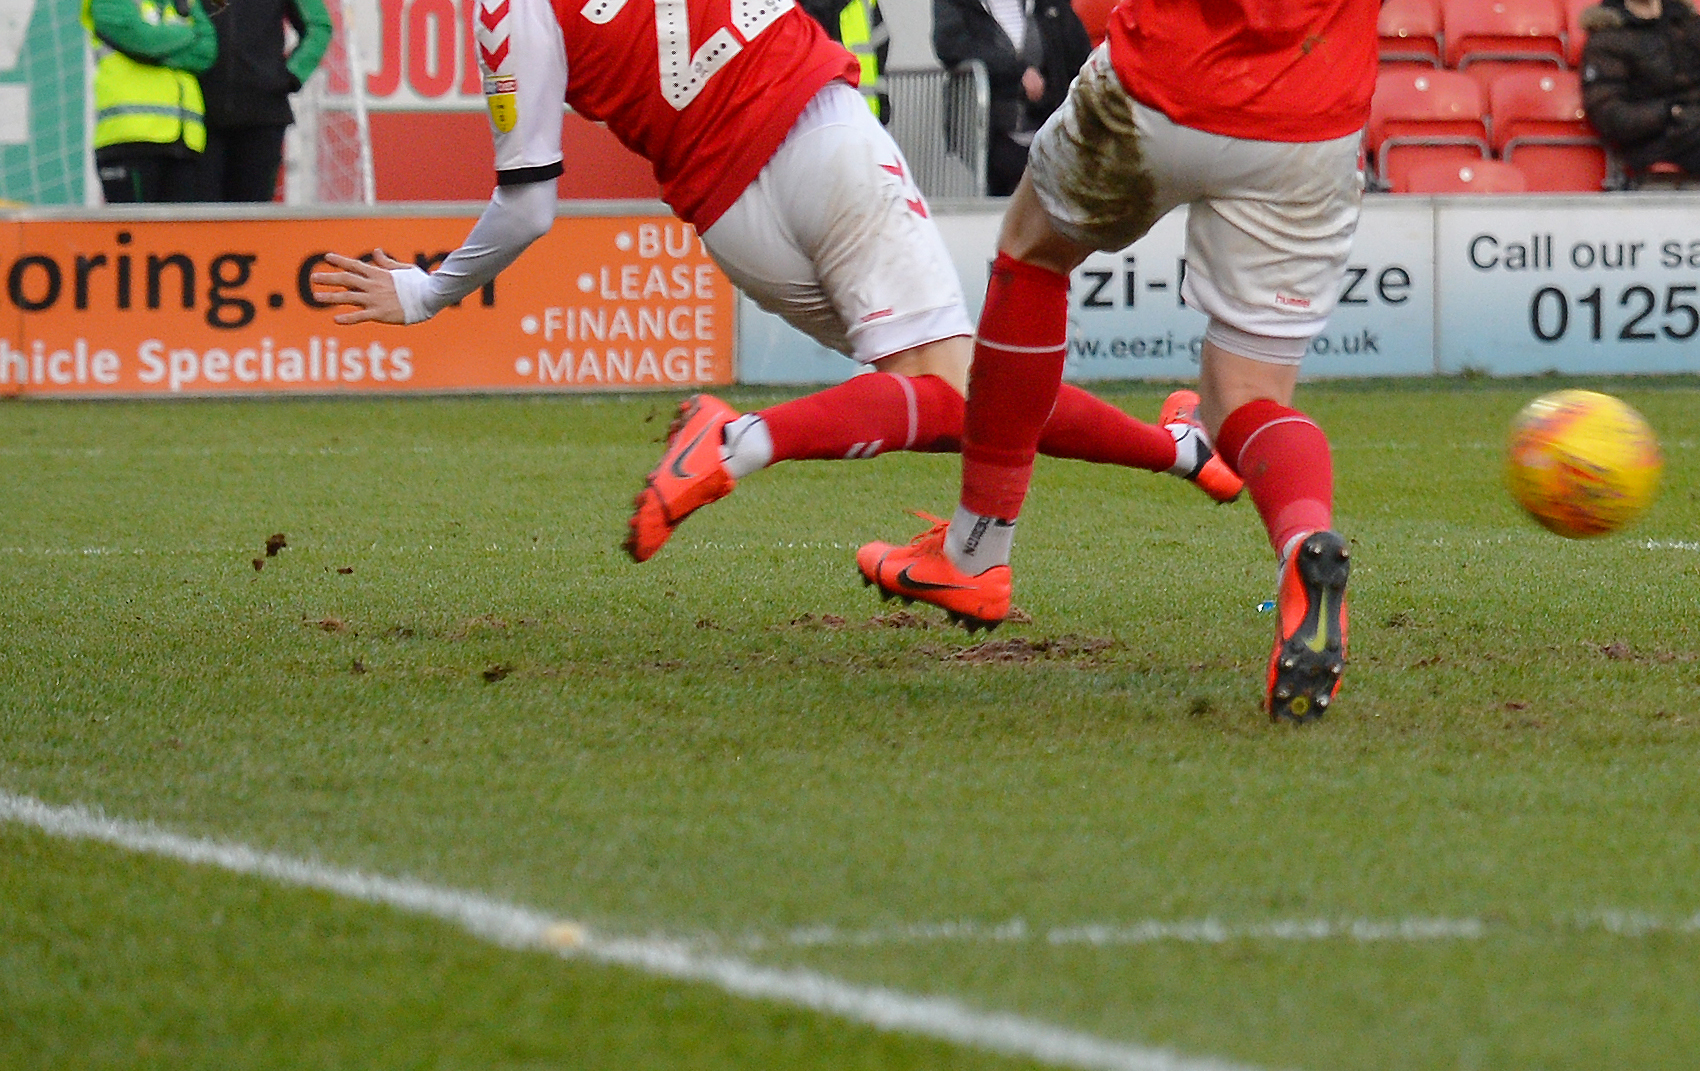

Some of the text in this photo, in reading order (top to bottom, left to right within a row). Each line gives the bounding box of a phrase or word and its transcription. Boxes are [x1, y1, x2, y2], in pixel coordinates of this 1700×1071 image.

[1470, 234, 1552, 270] Call
[1571, 242, 1644, 269] our
[8, 232, 495, 329] oring.c
[600, 264, 715, 301] LEASE
[544, 305, 715, 341] FINANCE
[137, 336, 413, 392] Specialists
[537, 347, 715, 383] MANAGE
